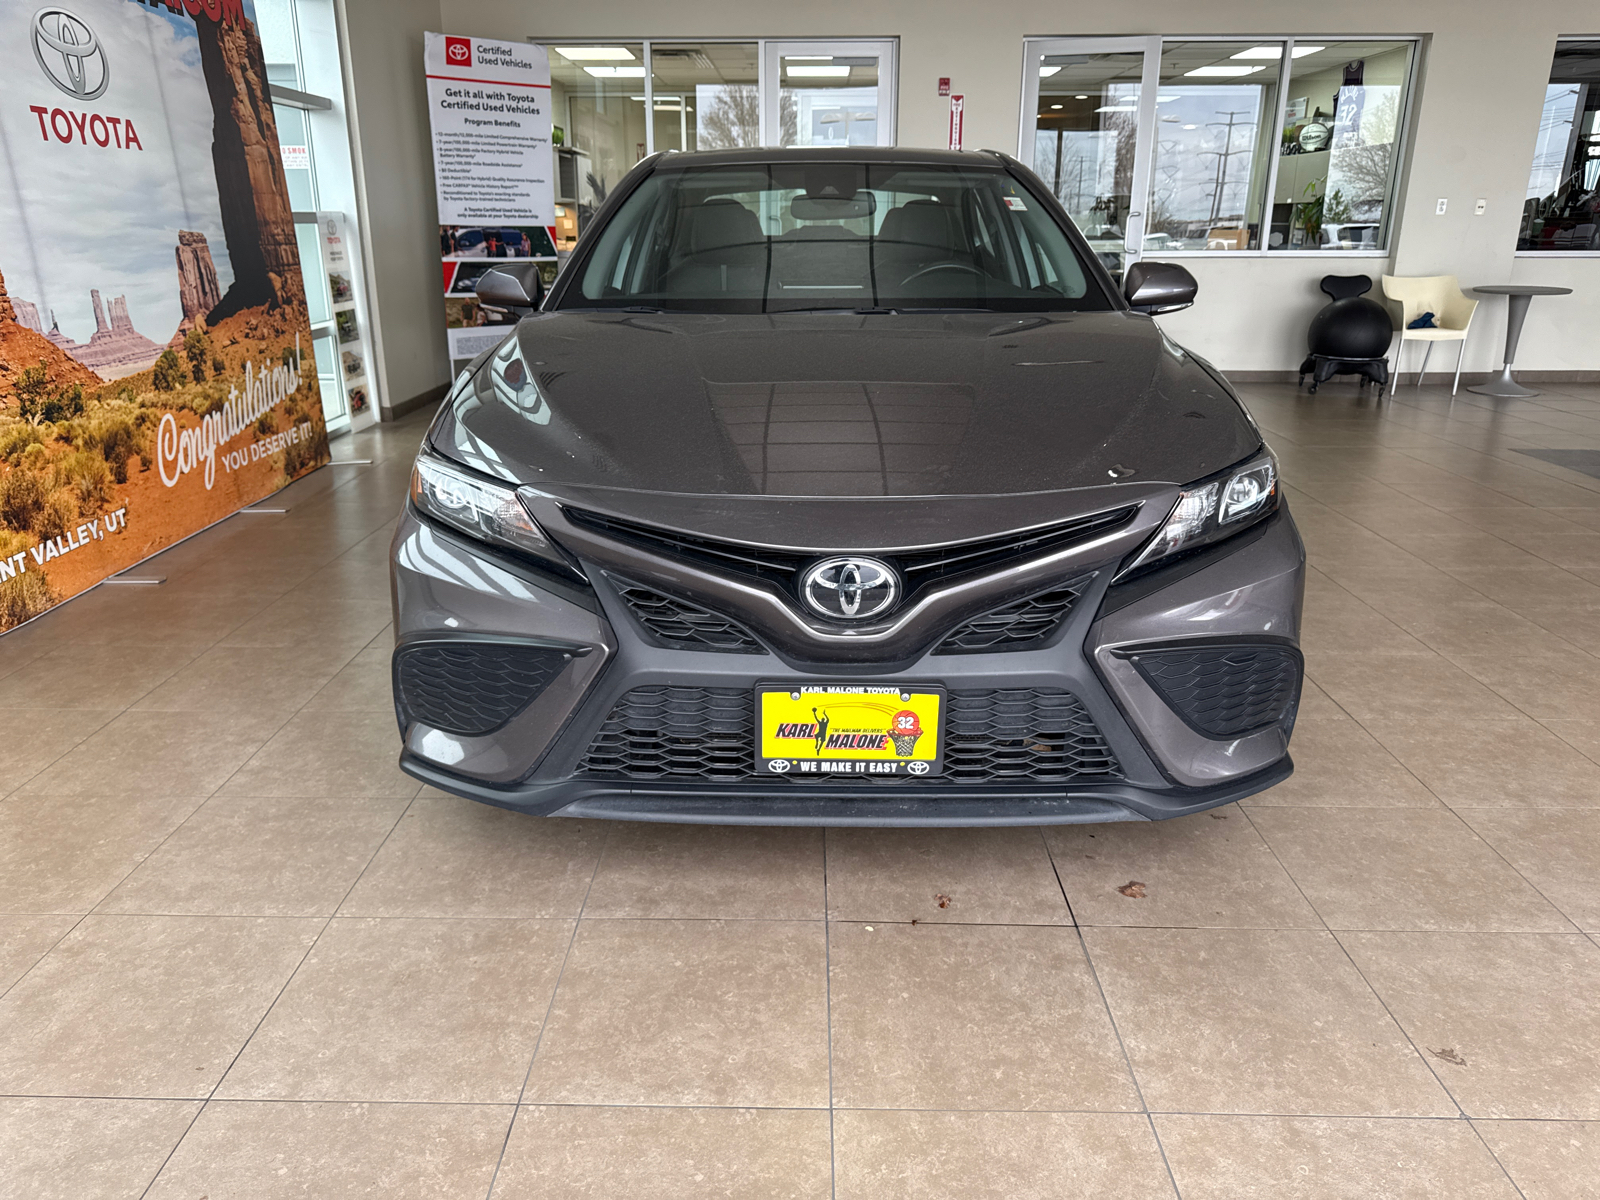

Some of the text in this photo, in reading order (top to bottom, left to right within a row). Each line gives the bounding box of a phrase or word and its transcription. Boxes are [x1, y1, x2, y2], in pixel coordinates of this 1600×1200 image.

[477, 45, 512, 56] Certified
[478, 56, 532, 69] Used Vehicles
[446, 88, 534, 104] Get it all with Toyota
[441, 100, 540, 115] Certified Used Vehicles
[29, 105, 143, 151] TOYOTA
[464, 118, 520, 128] Program Benefits
[157, 332, 303, 490] Congratulations!
[222, 421, 313, 473] YOU DESERVE IT!
[0, 508, 126, 583] NT VALLEY, UT
[898, 716, 914, 729] 32
[775, 723, 818, 739] KARL
[825, 734, 888, 750] MALONE
[800, 762, 898, 773] WE MAKE IT EASY
